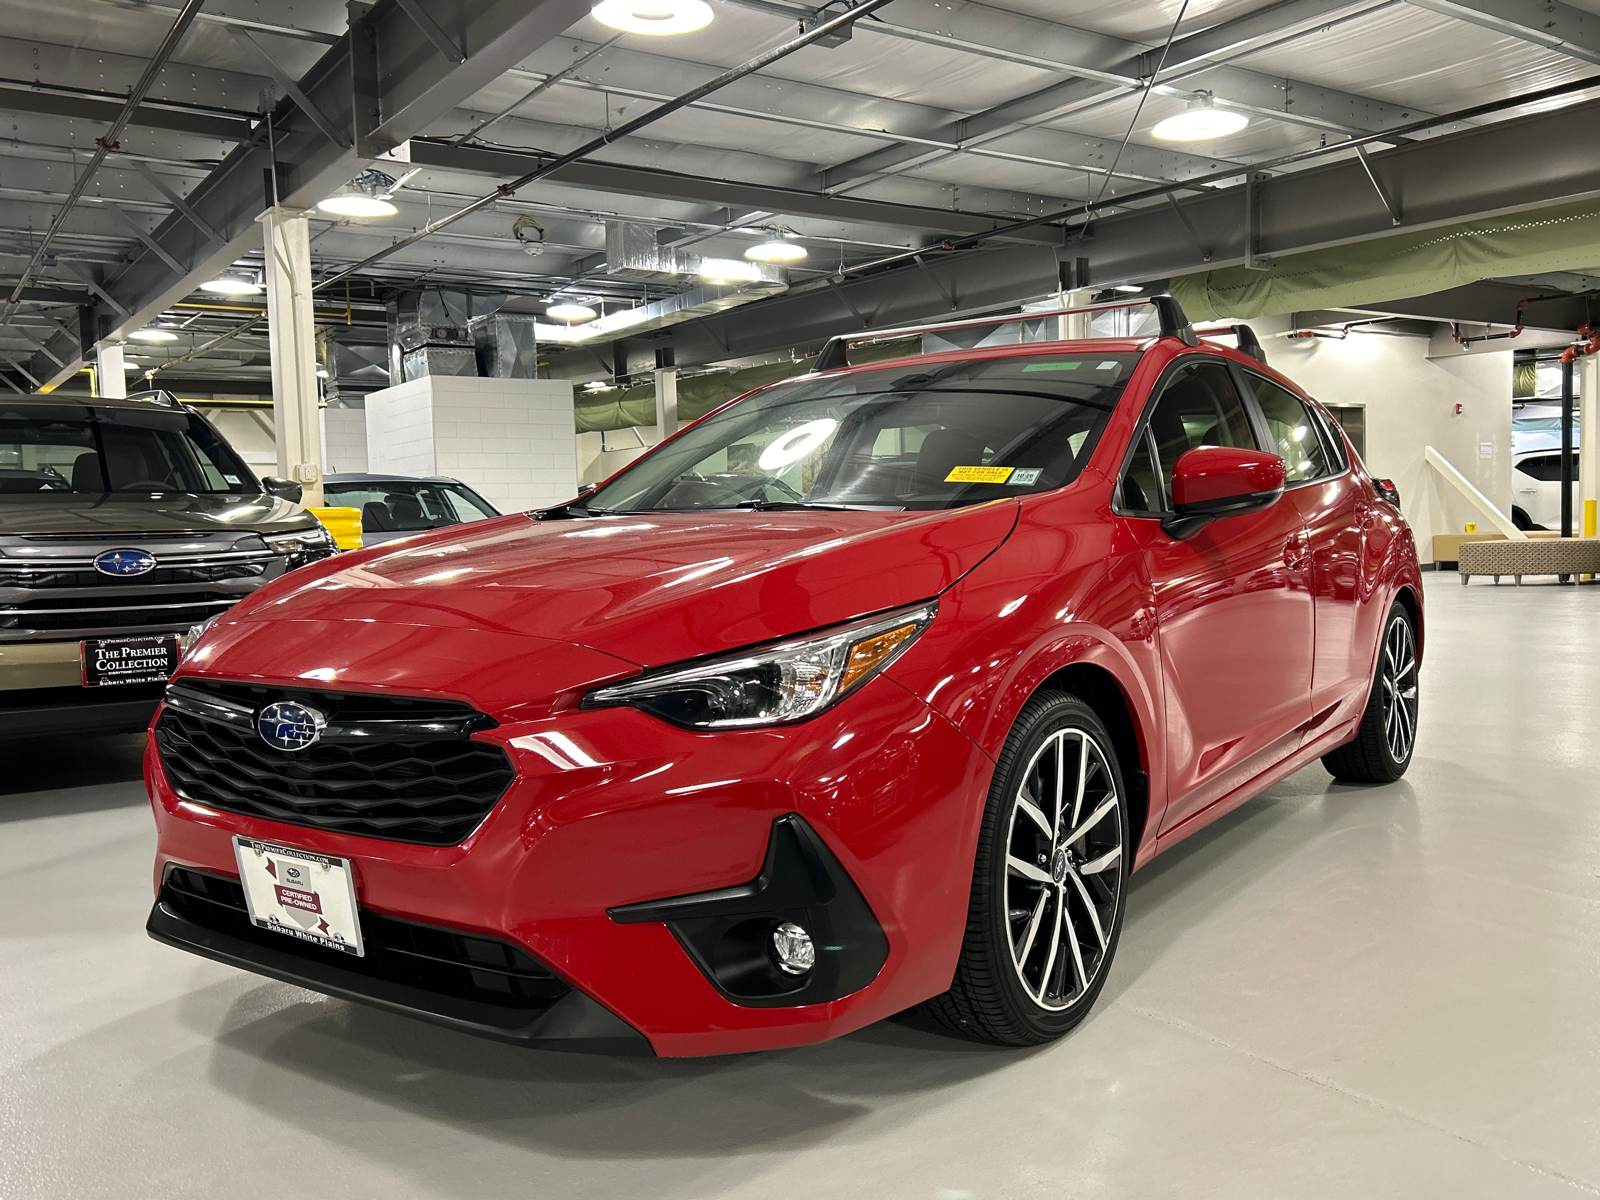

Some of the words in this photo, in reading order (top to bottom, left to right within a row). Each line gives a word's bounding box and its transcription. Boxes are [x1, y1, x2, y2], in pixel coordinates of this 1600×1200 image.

[95, 649, 120, 660] THE
[121, 646, 168, 658] PREMIER
[95, 658, 168, 671] COLLECTION
[147, 675, 169, 683] Plains
[286, 878, 304, 886] SUBARU
[281, 889, 313, 902] CERTIFIED
[280, 895, 317, 911] PRE-OWNED
[266, 922, 294, 936] Subaru
[295, 930, 318, 943] White
[320, 936, 345, 951] Plains
